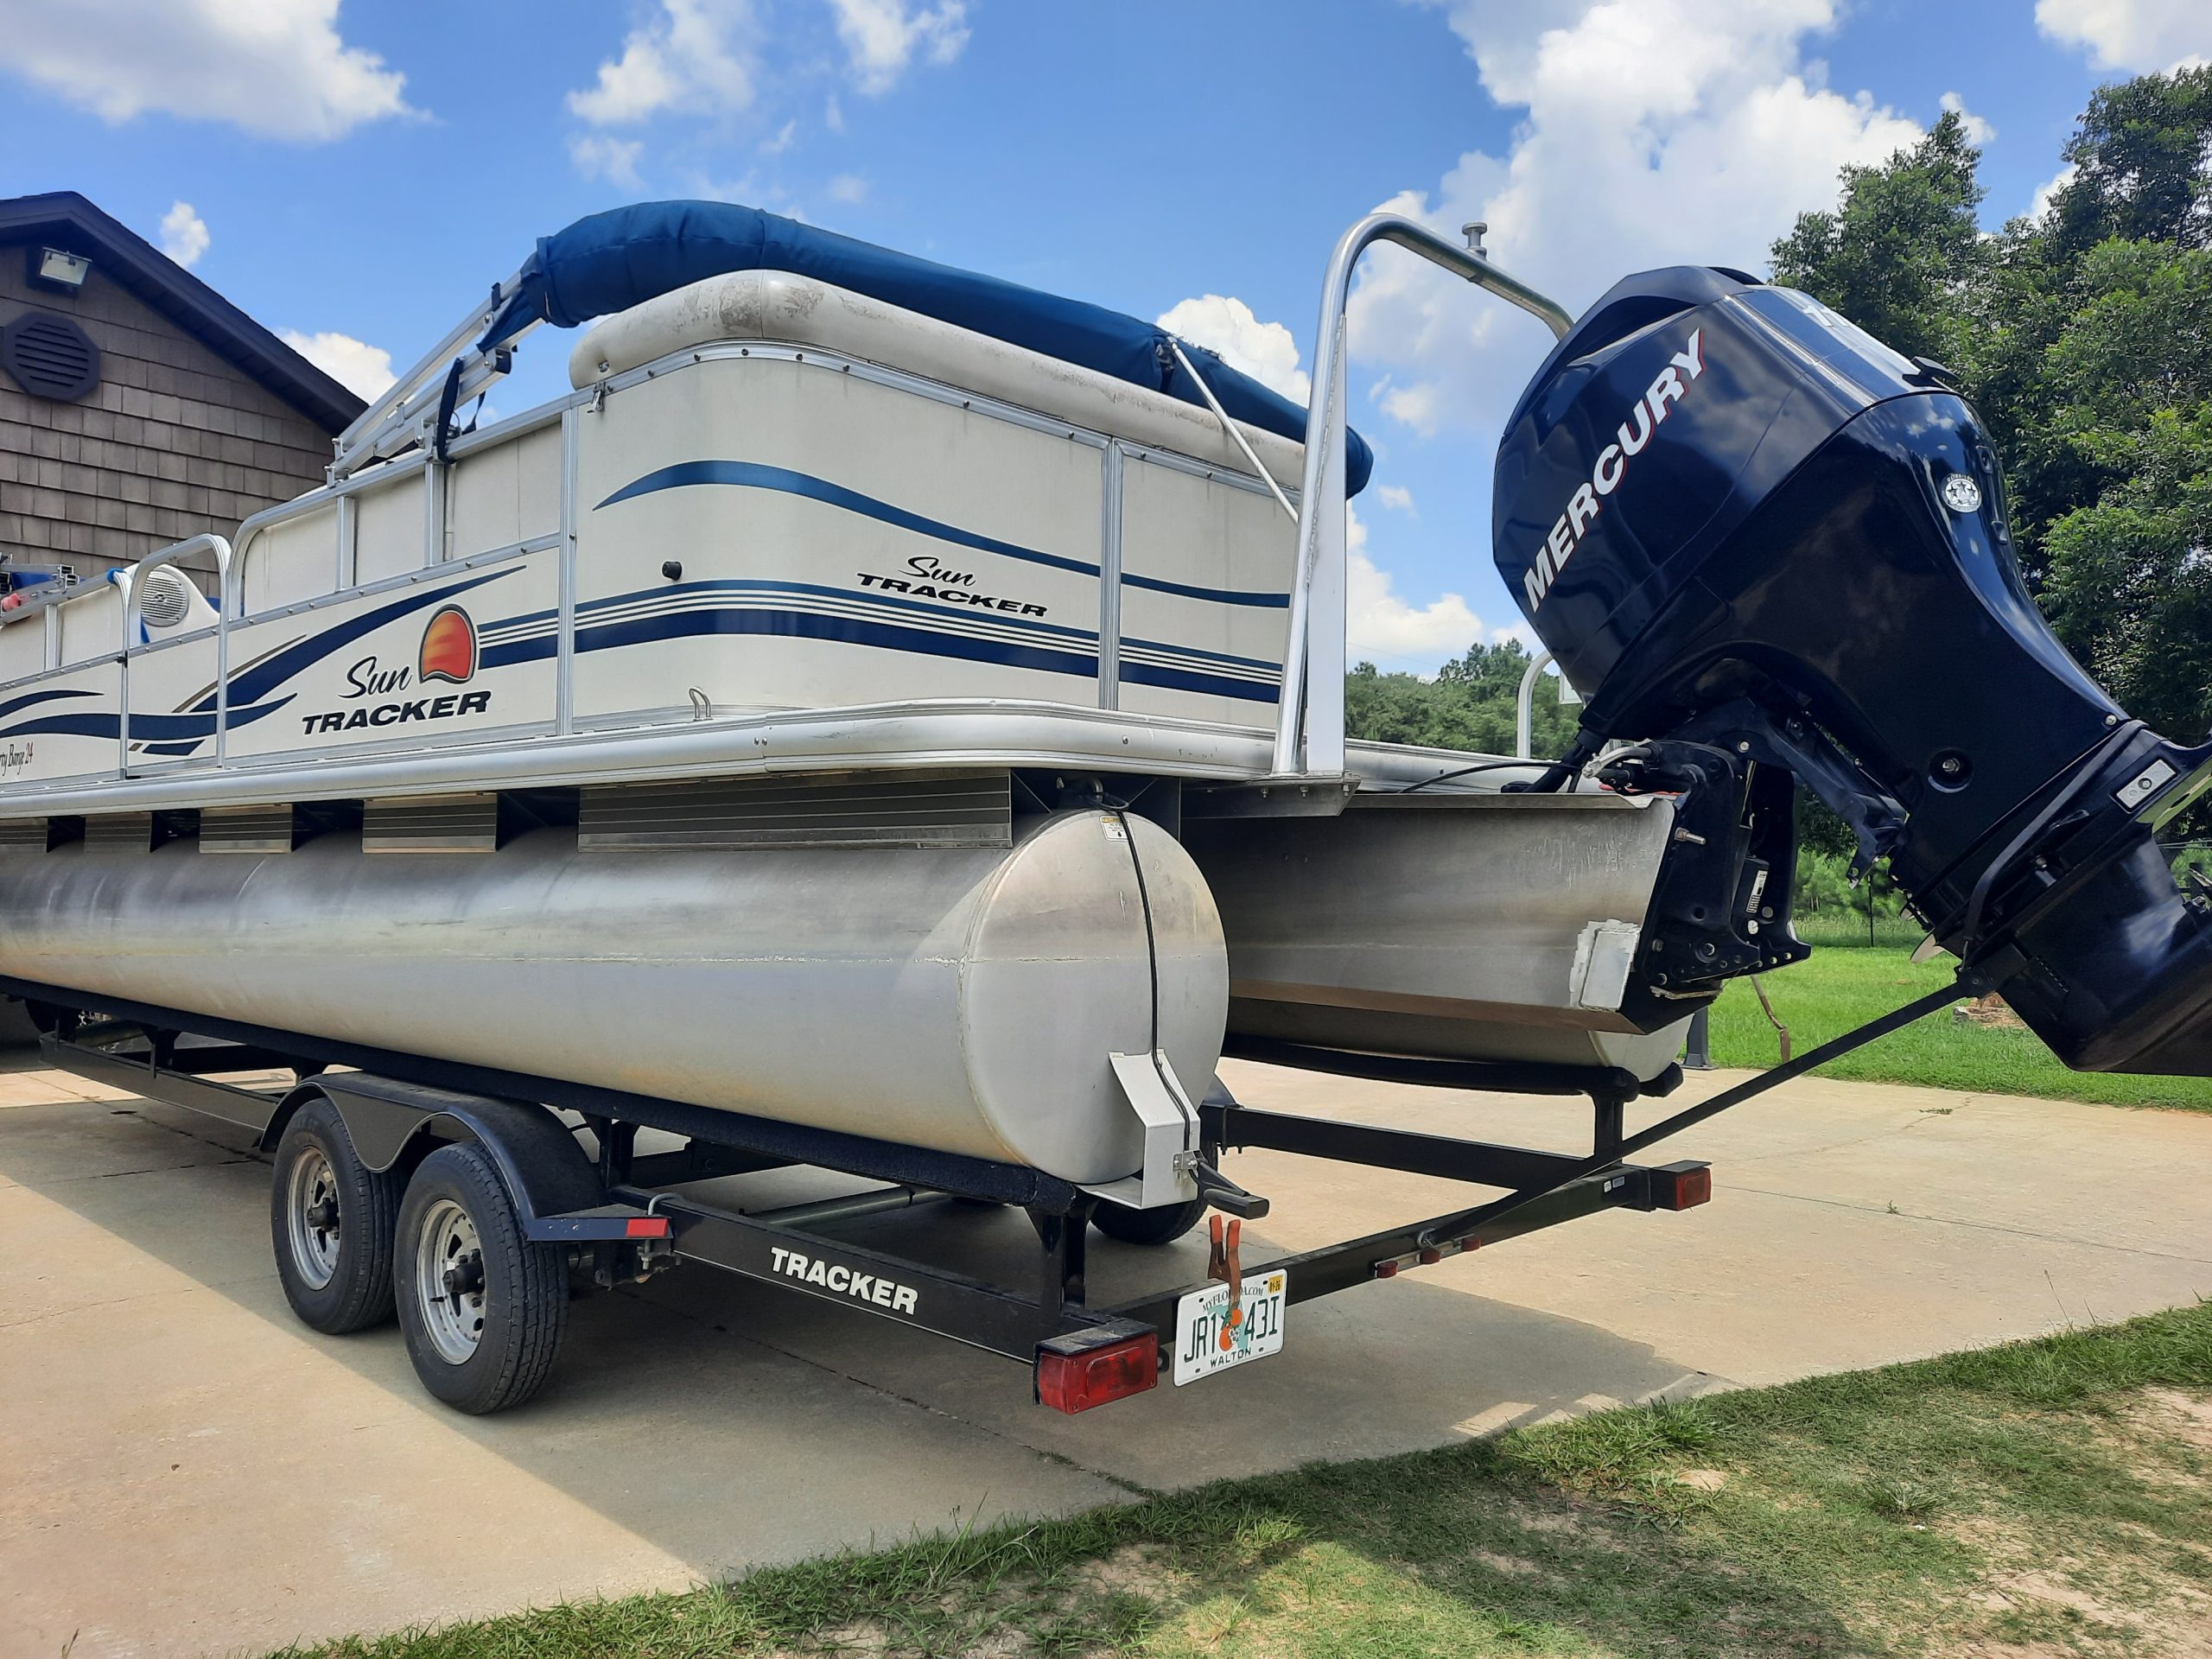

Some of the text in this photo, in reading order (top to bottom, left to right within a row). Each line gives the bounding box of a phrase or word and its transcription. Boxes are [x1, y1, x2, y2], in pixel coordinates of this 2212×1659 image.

[1523, 327, 1705, 613] MERCURY
[898, 556, 976, 587] Sun
[856, 573, 1048, 617] TRACKER
[338, 656, 412, 698] Sun
[302, 690, 492, 734] TRACKER
[771, 1247, 918, 1315] TRACKER
[1203, 1286, 1264, 1313] MYFLODA.COM
[1211, 1347, 1251, 1369] WALTON
